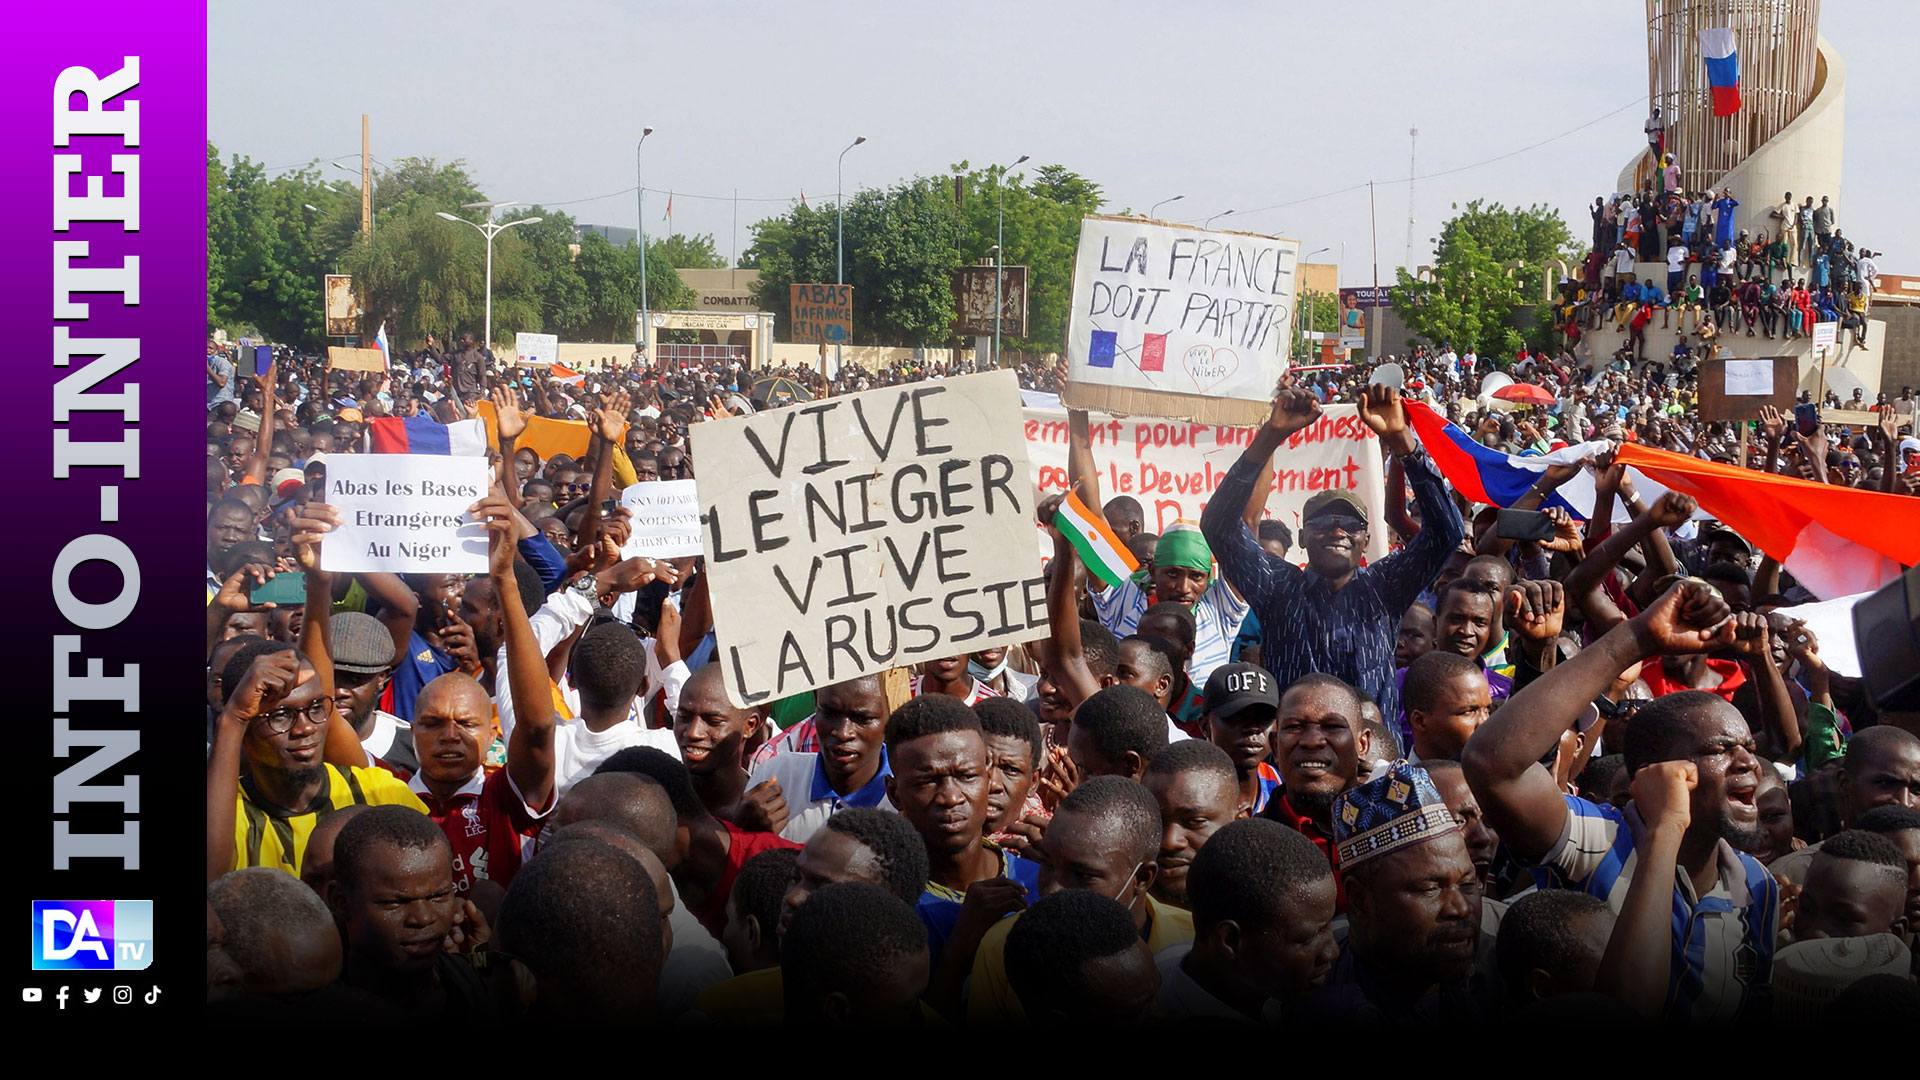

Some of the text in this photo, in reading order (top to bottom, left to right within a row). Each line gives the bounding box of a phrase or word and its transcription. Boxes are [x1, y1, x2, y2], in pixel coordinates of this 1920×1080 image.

[1099, 236, 1296, 296] LA FRANCE
[1179, 292, 1288, 356] PARTIR
[743, 386, 953, 479] VIVE
[1135, 423, 1210, 458] pour
[1216, 427, 1259, 448] un
[332, 480, 478, 498] Abas les Bases
[1109, 460, 1133, 493] le
[630, 496, 654, 506] ANS
[701, 454, 1021, 563] LE NIGER
[355, 510, 464, 531] Etrangères
[367, 542, 451, 562] Au Niger
[773, 524, 972, 616] VIVE
[730, 577, 1050, 706] LA RUSSIE
[1227, 671, 1268, 692] OFF
